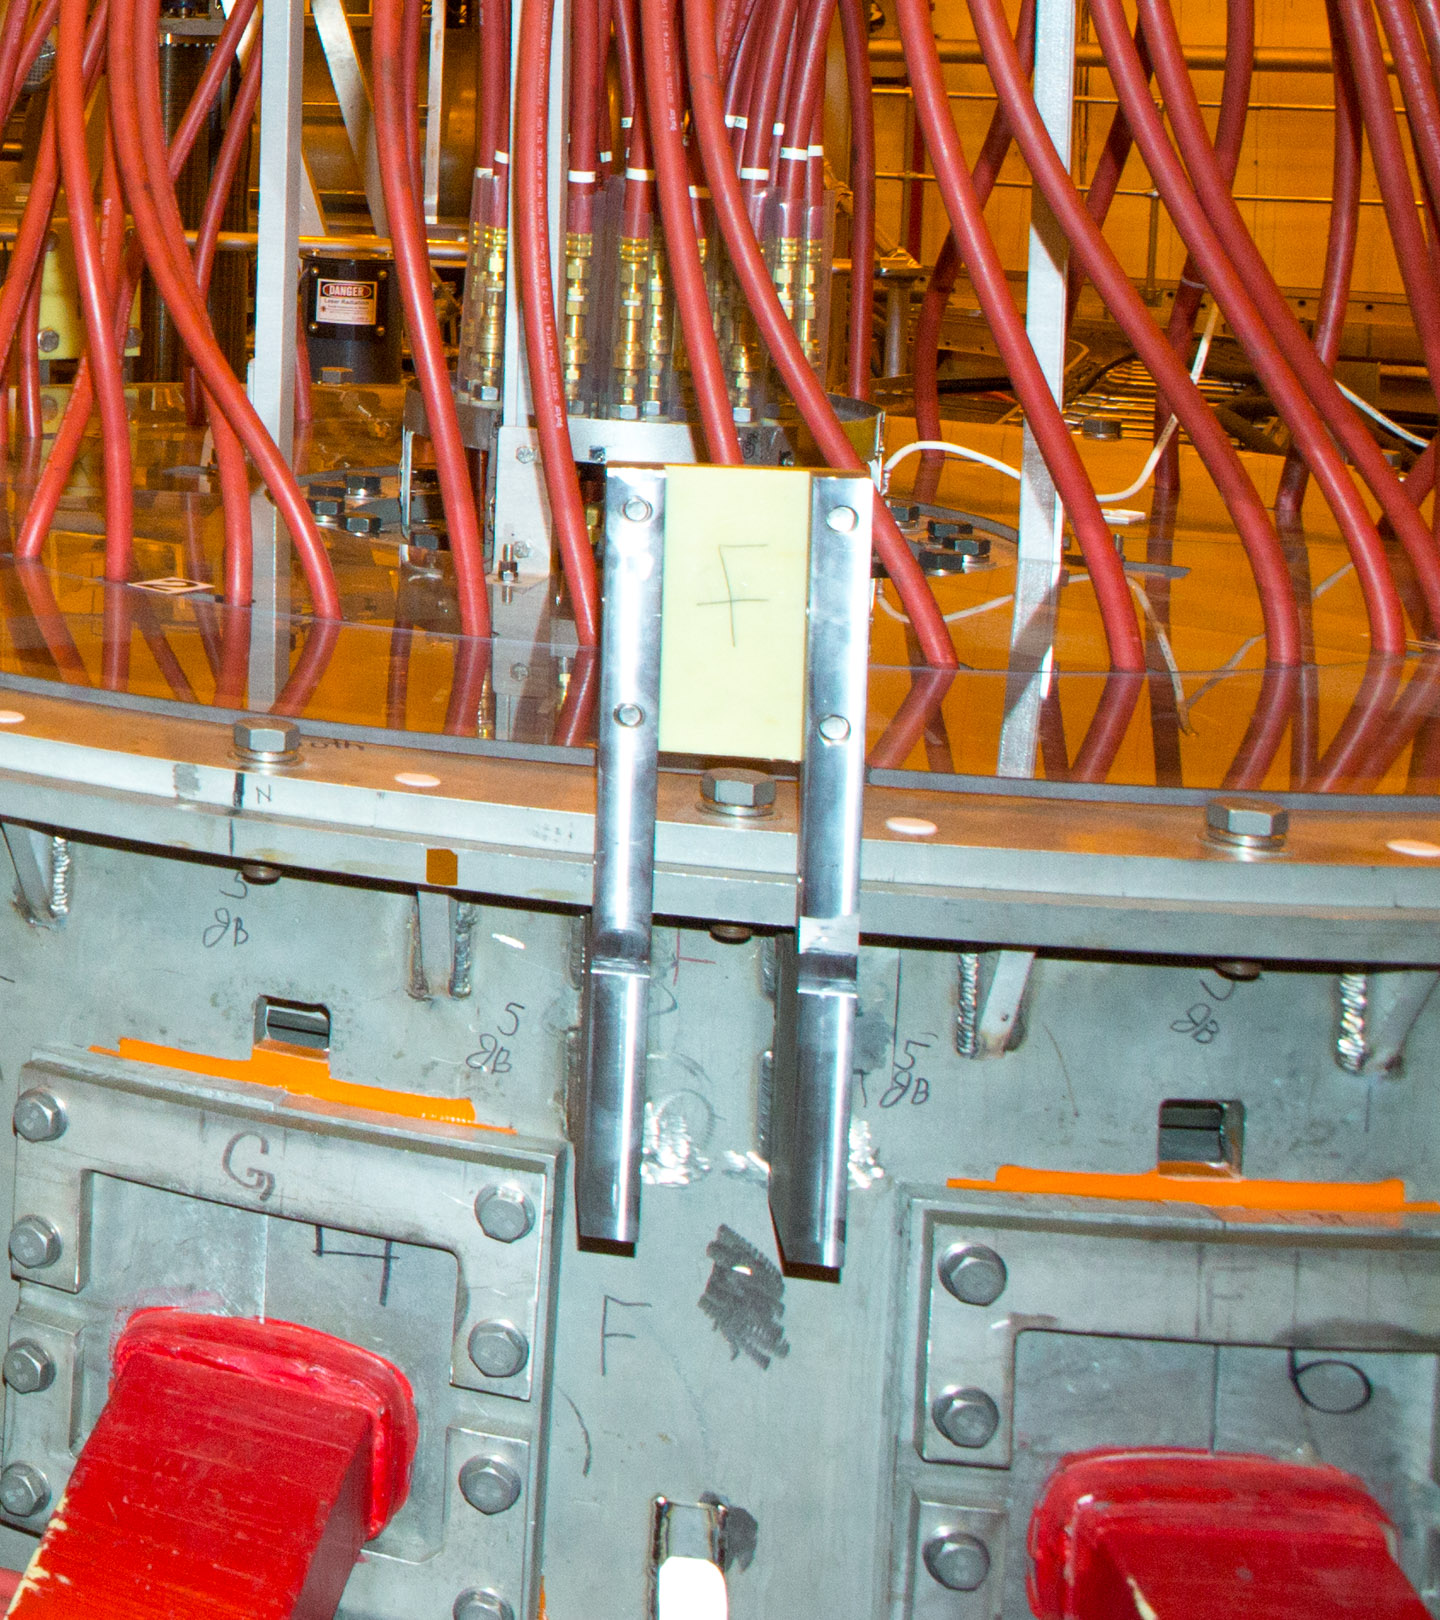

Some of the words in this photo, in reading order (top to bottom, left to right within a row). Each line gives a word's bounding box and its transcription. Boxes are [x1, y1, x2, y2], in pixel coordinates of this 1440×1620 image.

[329, 285, 364, 296] DANGER
[255, 783, 272, 804] N
[496, 1001, 525, 1037] 5
[221, 1131, 276, 1201] G
[601, 1295, 652, 1376] F
